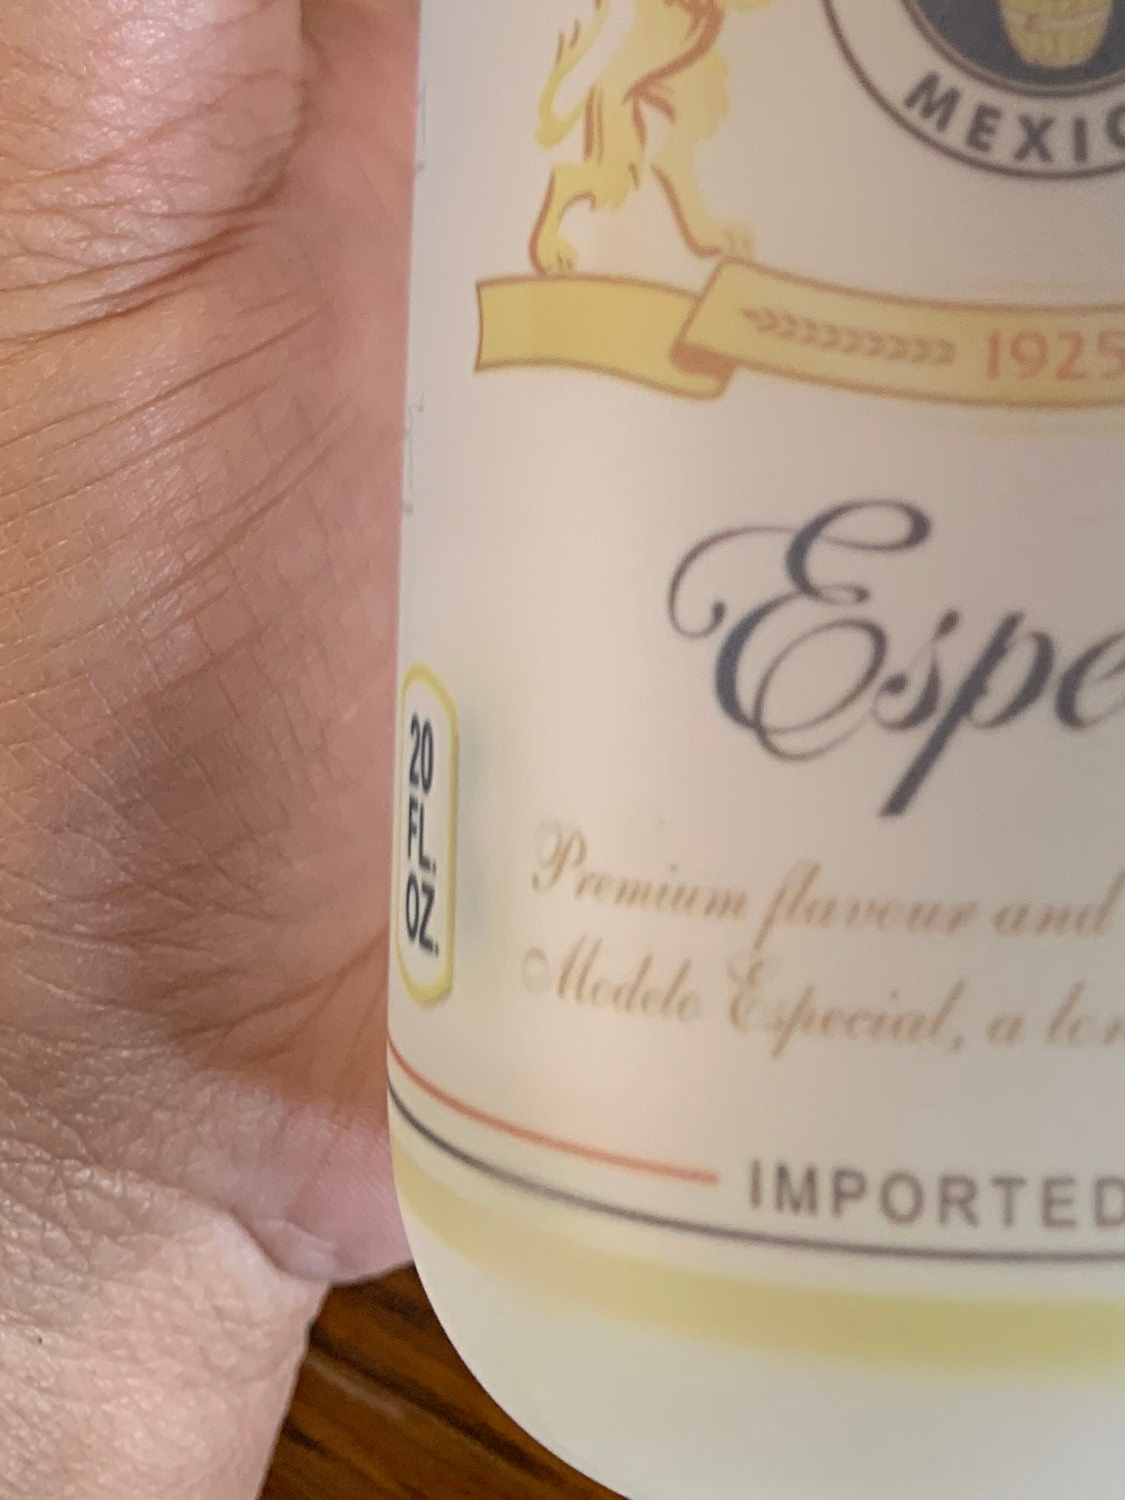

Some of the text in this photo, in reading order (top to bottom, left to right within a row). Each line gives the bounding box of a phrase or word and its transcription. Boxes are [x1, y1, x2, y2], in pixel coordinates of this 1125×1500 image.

[408, 711, 434, 795] 20
[531, 817, 748, 921] Premium
[752, 859, 978, 952] flavour
[520, 933, 701, 1022] Modelo
[727, 954, 968, 1060] Especial,
[985, 1012, 1024, 1046] a
